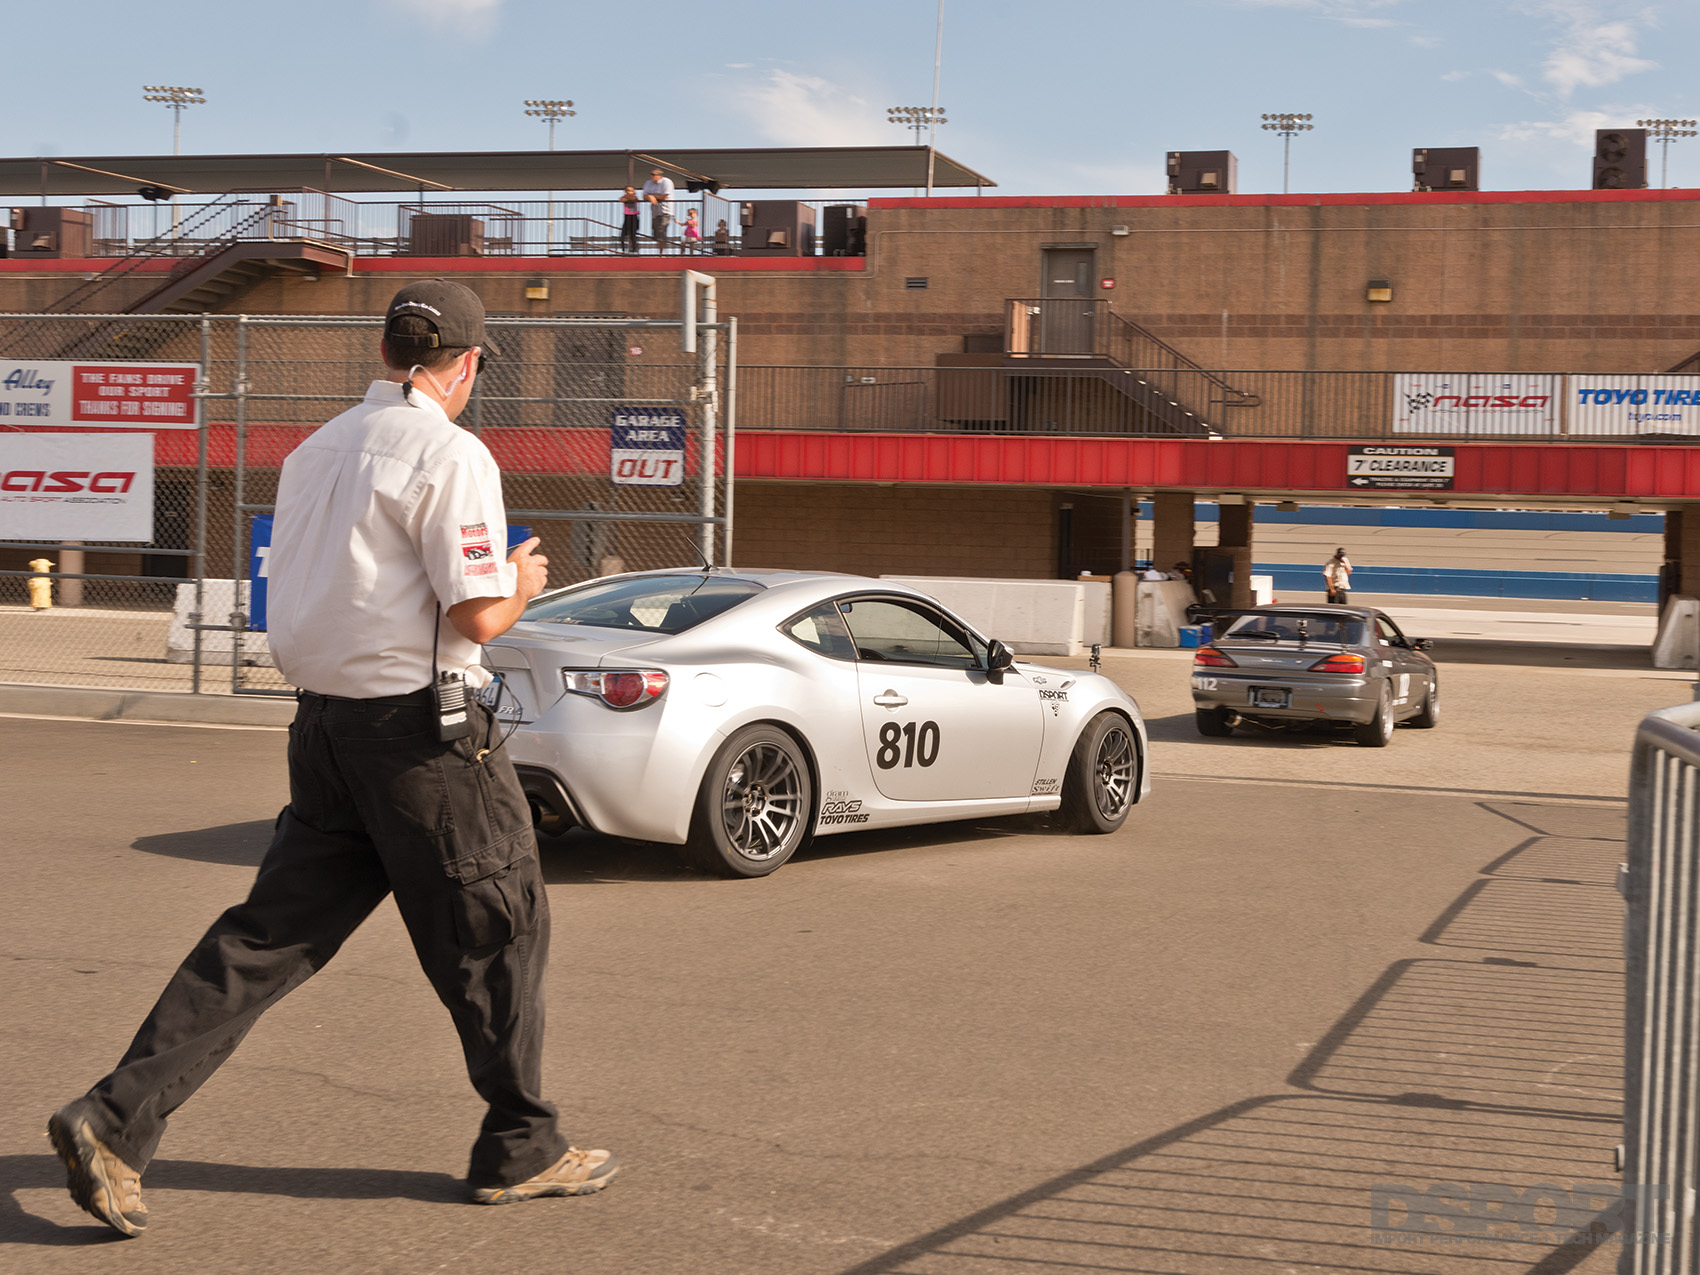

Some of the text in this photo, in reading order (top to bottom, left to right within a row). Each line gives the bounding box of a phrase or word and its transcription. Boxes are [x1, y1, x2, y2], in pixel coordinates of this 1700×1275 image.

[2, 369, 55, 396] Alley
[80, 373, 106, 384] THE
[109, 373, 143, 385] FANS
[1433, 395, 1551, 408] nasa
[1578, 388, 1648, 406] TOYO
[615, 415, 680, 427] GARAGE
[625, 430, 670, 442] AREA
[1362, 447, 1439, 456] CAUTION
[616, 459, 678, 478] OUT
[1369, 460, 1447, 472] CLEARANCE
[0, 470, 137, 493] asa
[876, 720, 941, 770] 810
[821, 800, 863, 815] RAYS
